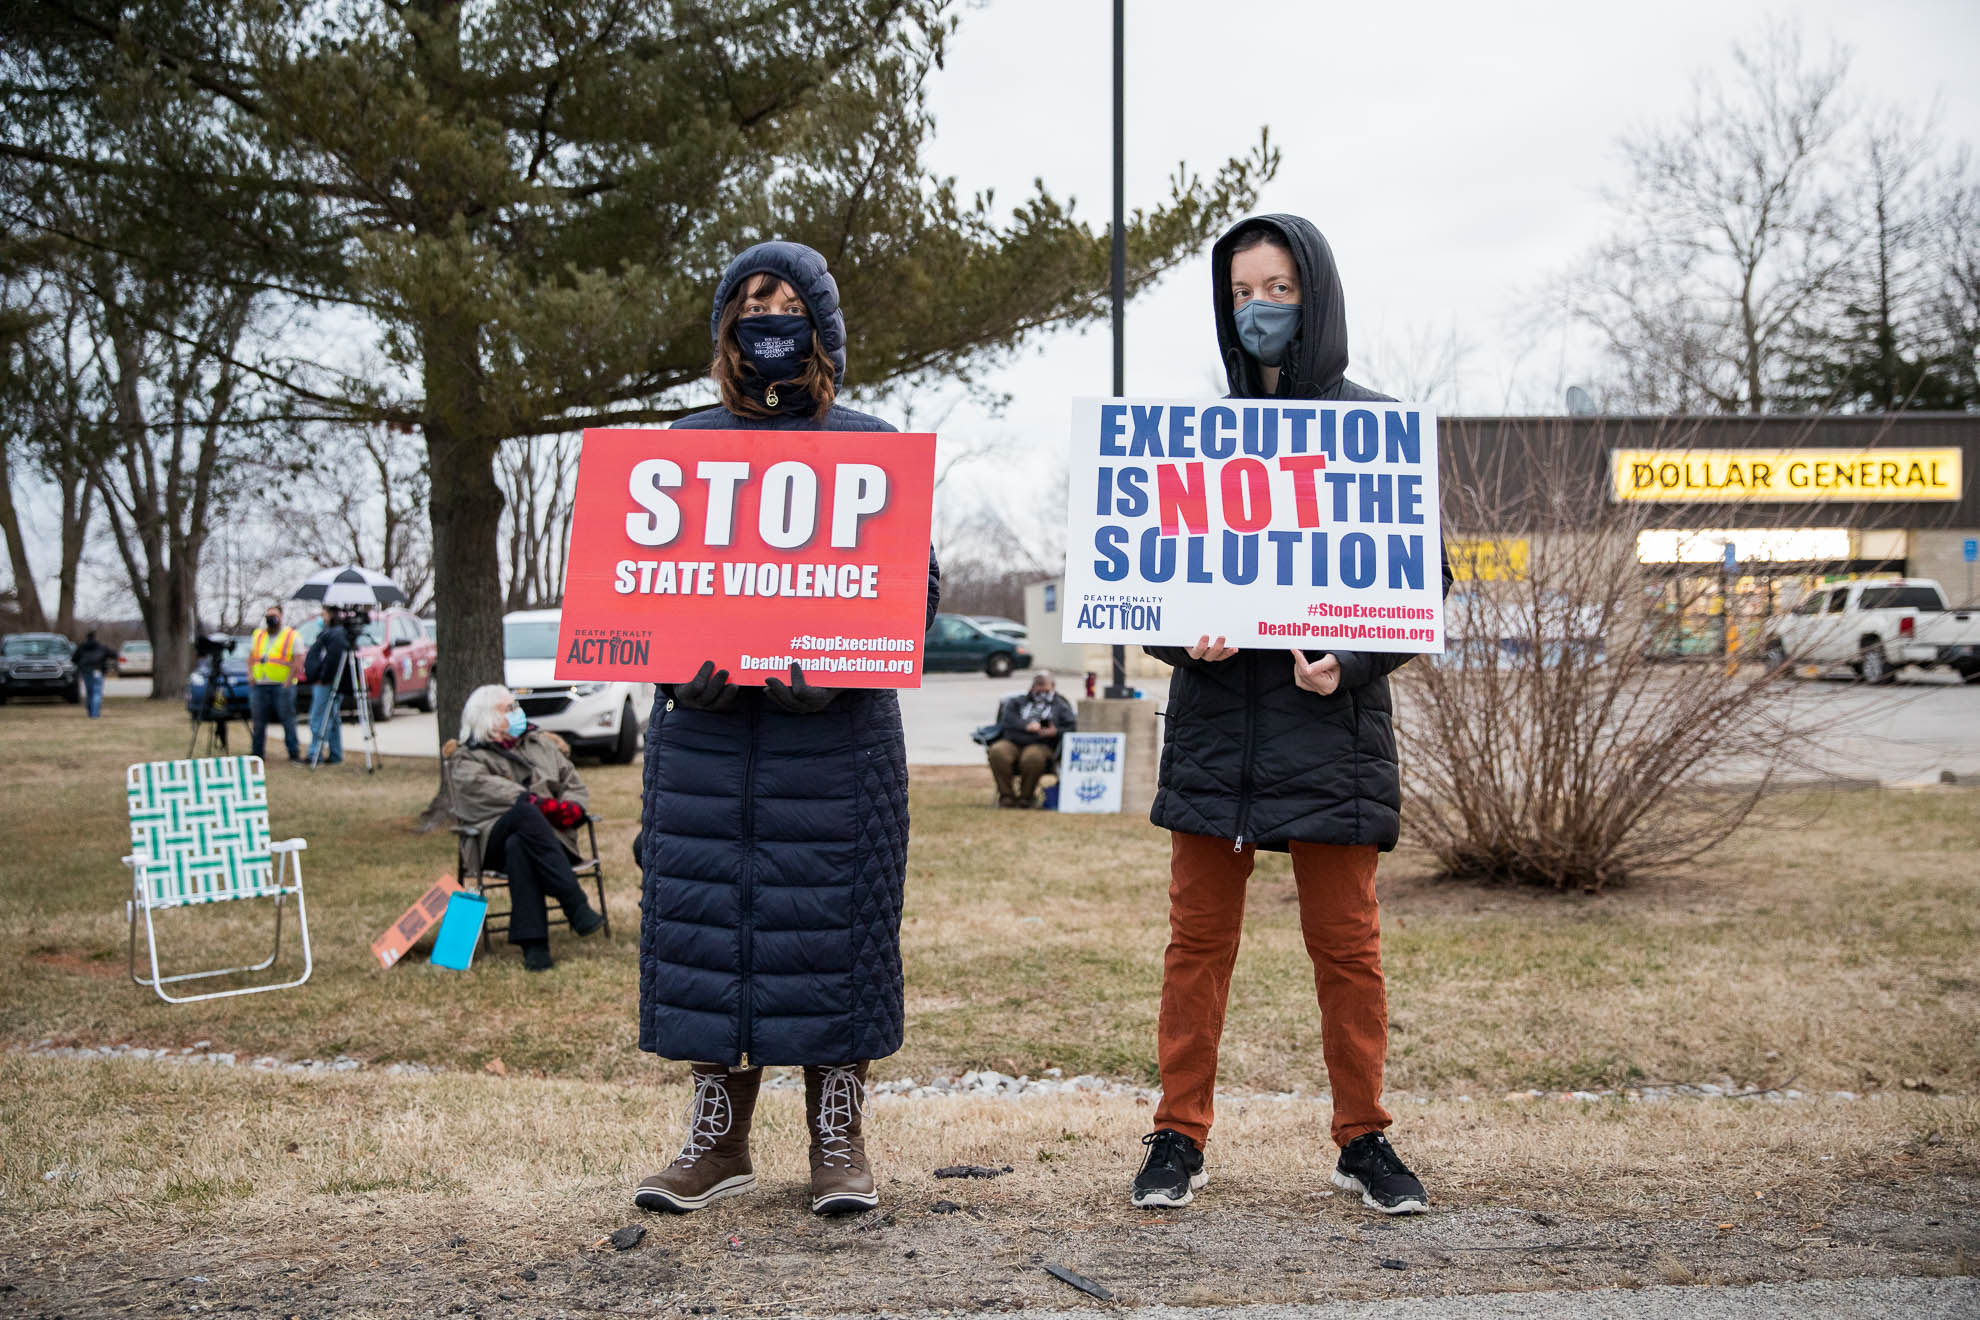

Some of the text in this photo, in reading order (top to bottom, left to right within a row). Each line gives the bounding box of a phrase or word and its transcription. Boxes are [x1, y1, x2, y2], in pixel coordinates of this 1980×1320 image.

[1099, 405, 1421, 464] EXECUTION
[1632, 462, 1947, 488] DOLLAR GENERAL
[625, 458, 888, 549] STOP
[1096, 454, 1425, 537] IS NOT THE
[1094, 525, 1425, 590] SOLUTION
[614, 560, 879, 599] STATE VIOLENCE
[1083, 594, 1163, 603] DEATH PENALTY
[1307, 602, 1435, 620] #StopExecutions
[1076, 602, 1161, 631] ACTION
[575, 629, 653, 638] DEATH PENALTY
[790, 635, 915, 651] #StopExecutions
[1258, 621, 1435, 642] DeathPenaltyAction.org
[566, 637, 650, 665] ACTION
